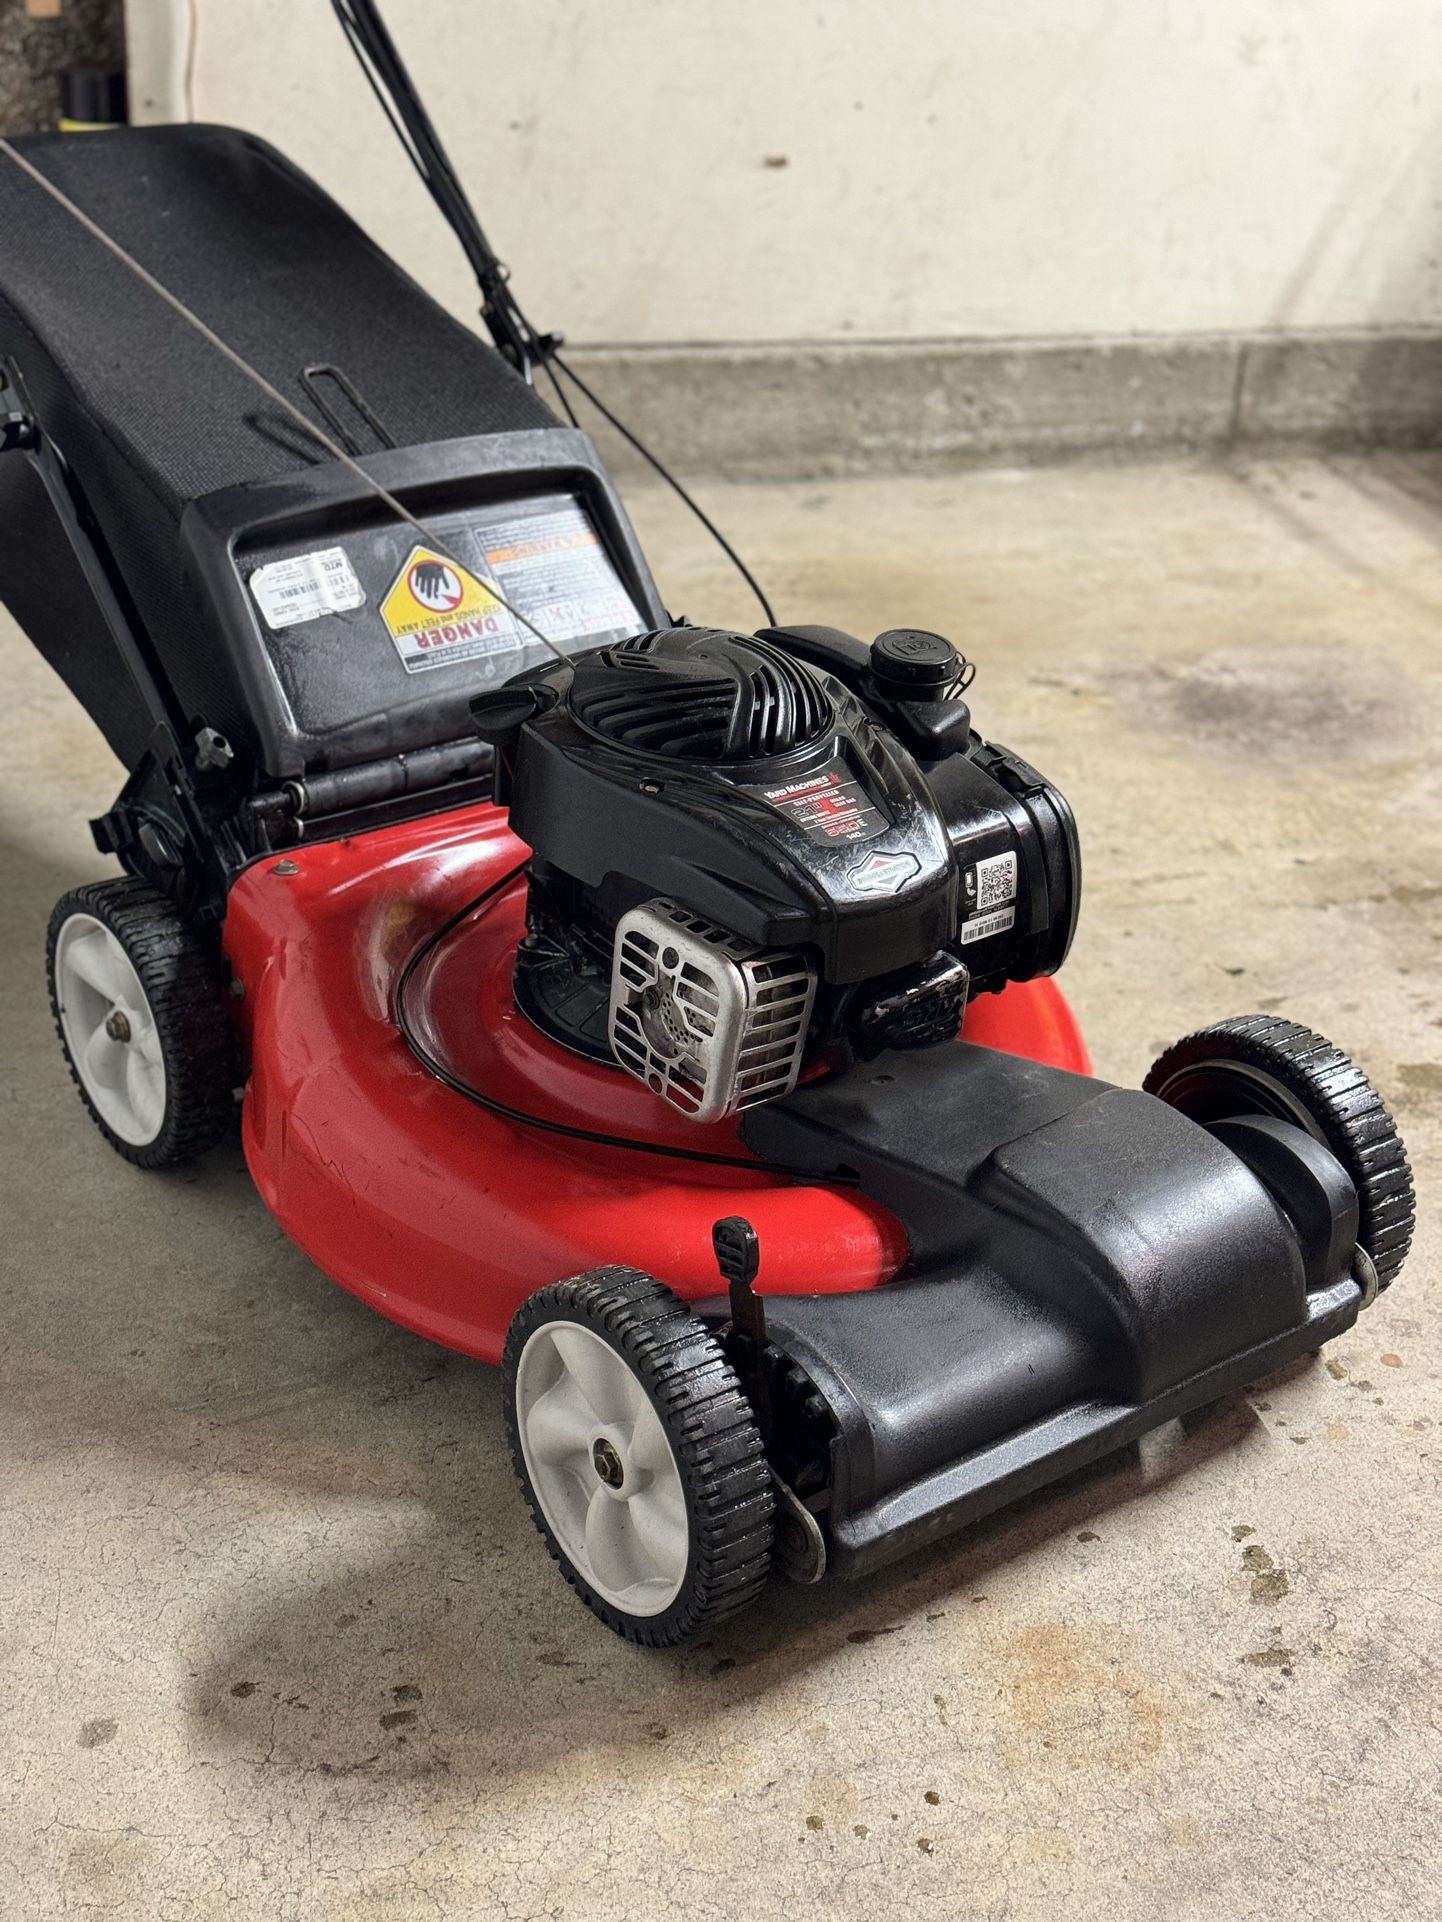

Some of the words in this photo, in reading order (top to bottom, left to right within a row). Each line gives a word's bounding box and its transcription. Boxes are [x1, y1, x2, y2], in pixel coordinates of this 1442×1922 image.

[324, 560, 343, 572] MTD
[456, 608, 481, 621] HANDS
[396, 622, 419, 635] AWAY
[422, 618, 441, 629] FEET
[414, 617, 499, 649] DANGER
[764, 788, 788, 800] YARD
[785, 776, 830, 793] MACHINES
